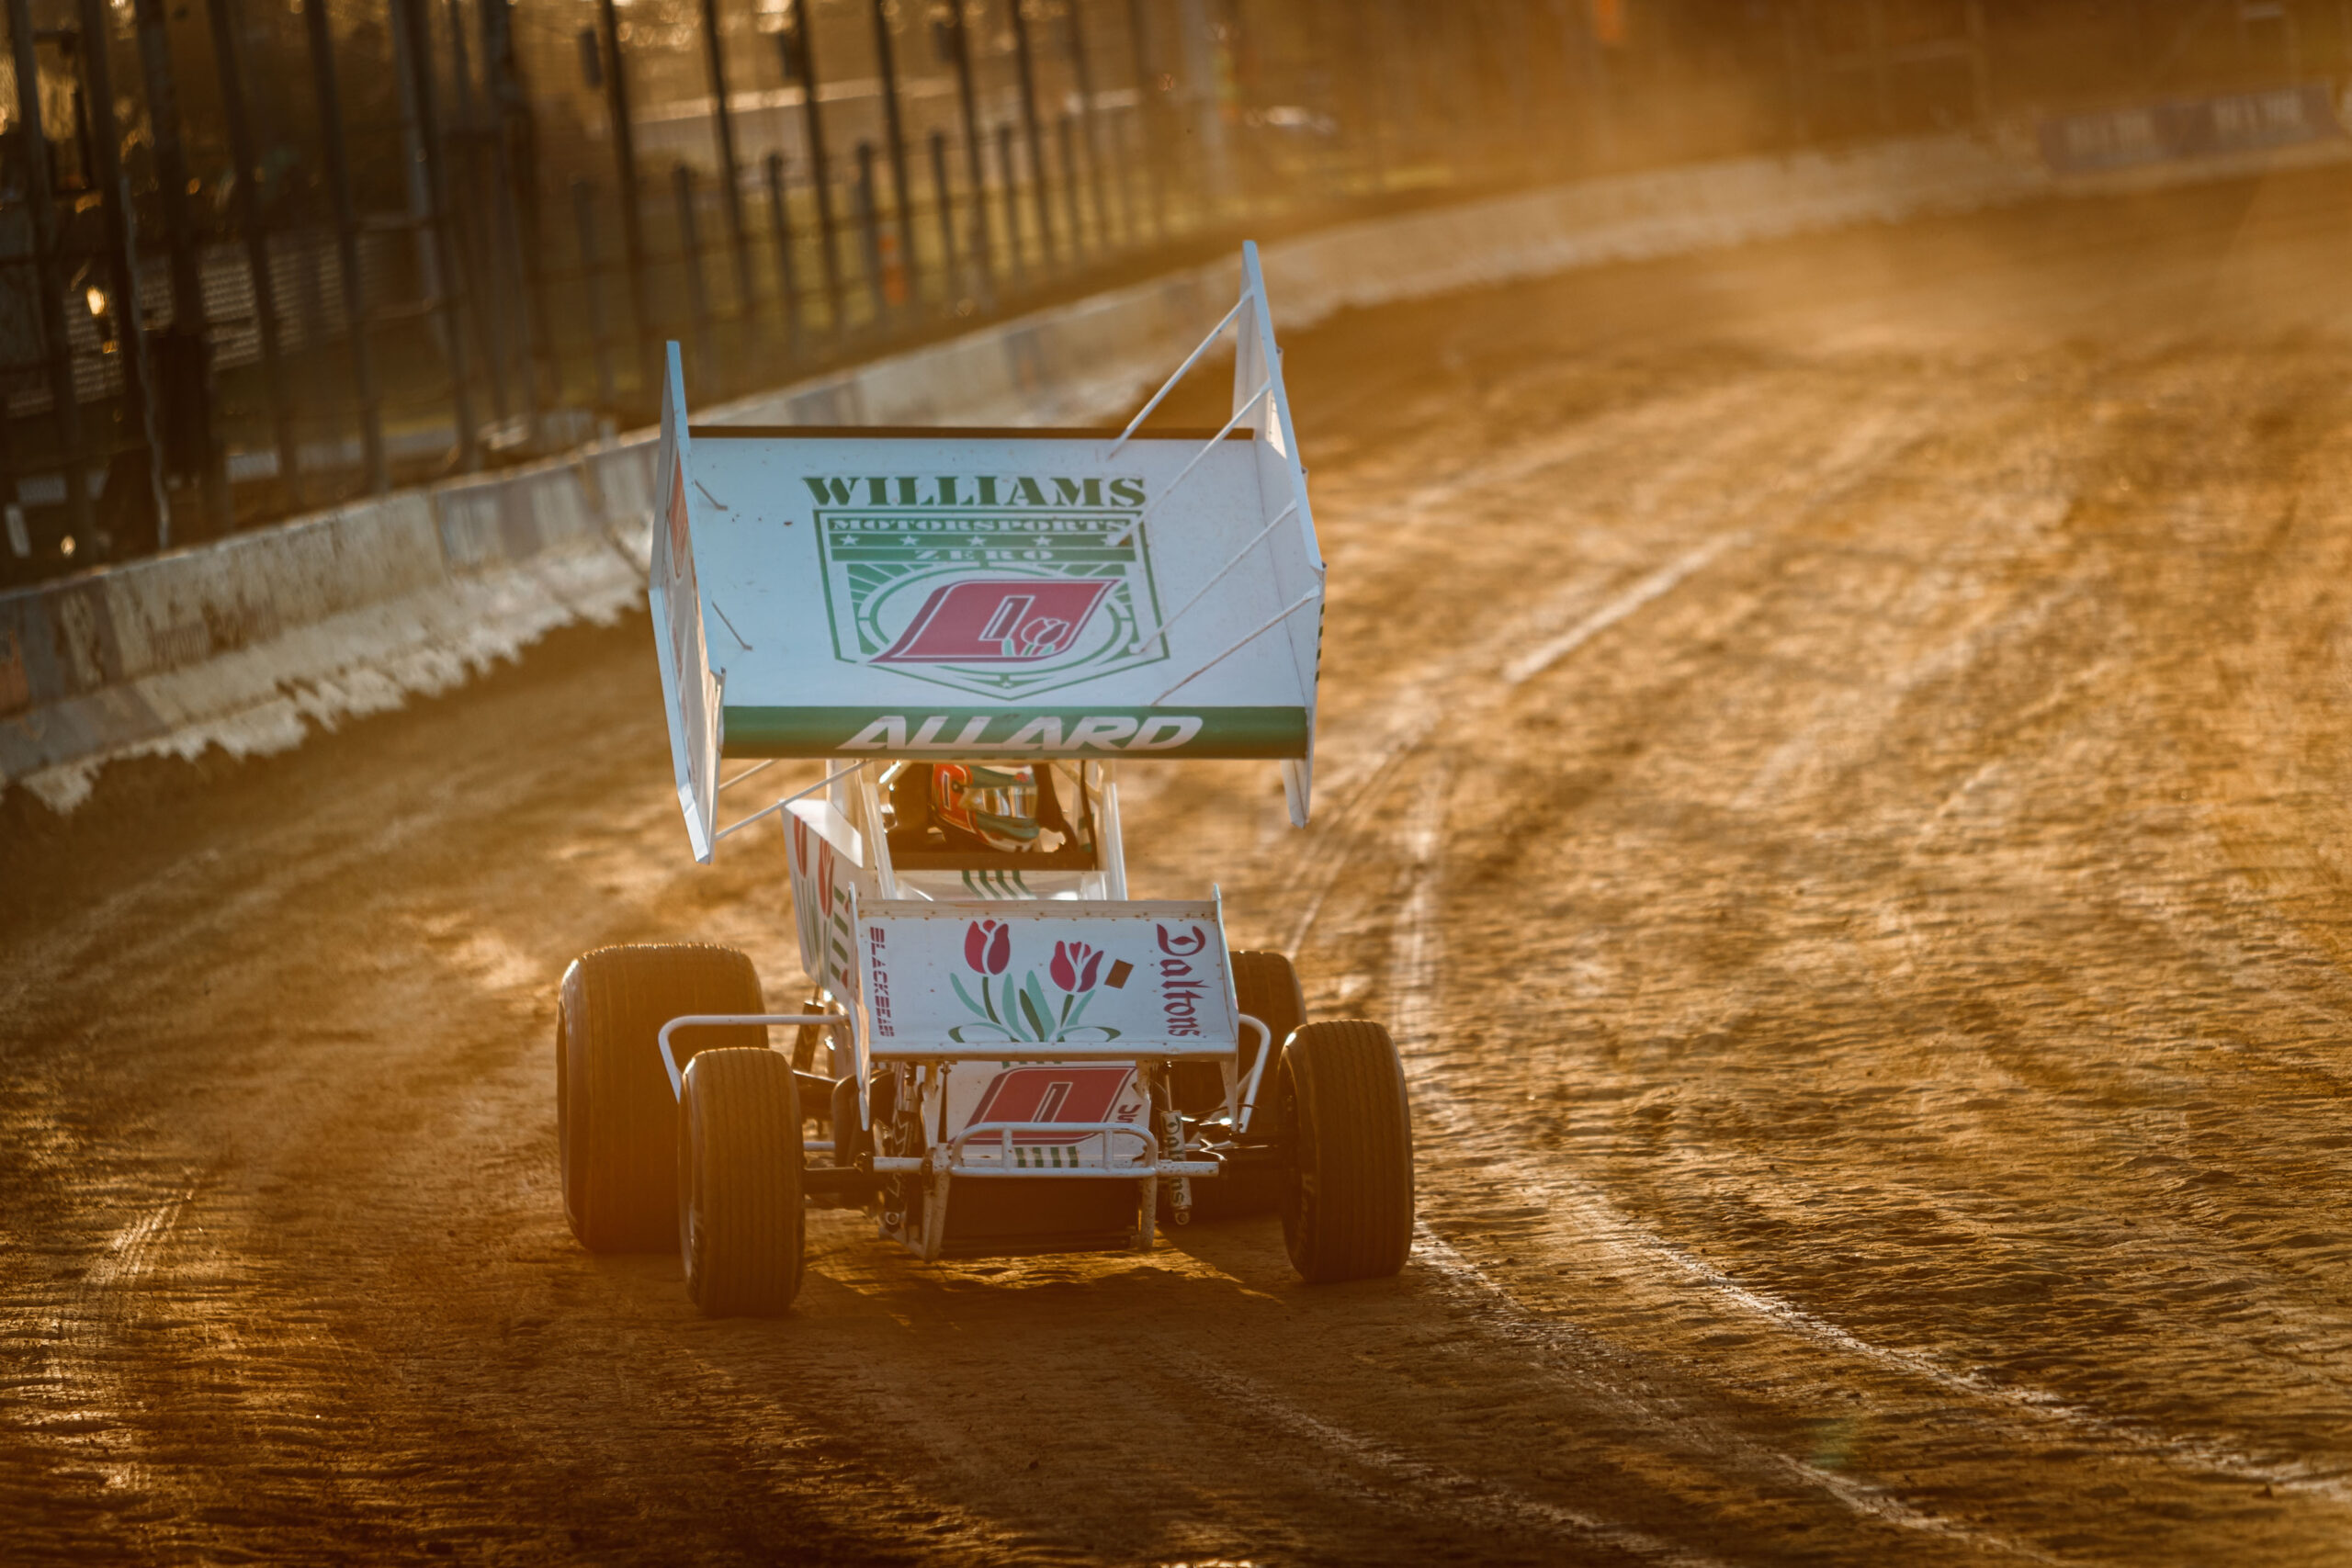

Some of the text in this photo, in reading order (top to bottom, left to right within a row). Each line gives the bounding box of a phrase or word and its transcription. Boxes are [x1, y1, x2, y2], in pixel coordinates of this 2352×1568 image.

[802, 476, 1147, 507] WILLIAMS
[831, 519, 1127, 532] MOTORSPORTS
[914, 549, 1054, 562] ZERO
[835, 716, 1204, 750] ALLARD
[869, 926, 895, 1037] BLACKBEAR
[1156, 923, 1213, 1037] Daltons
